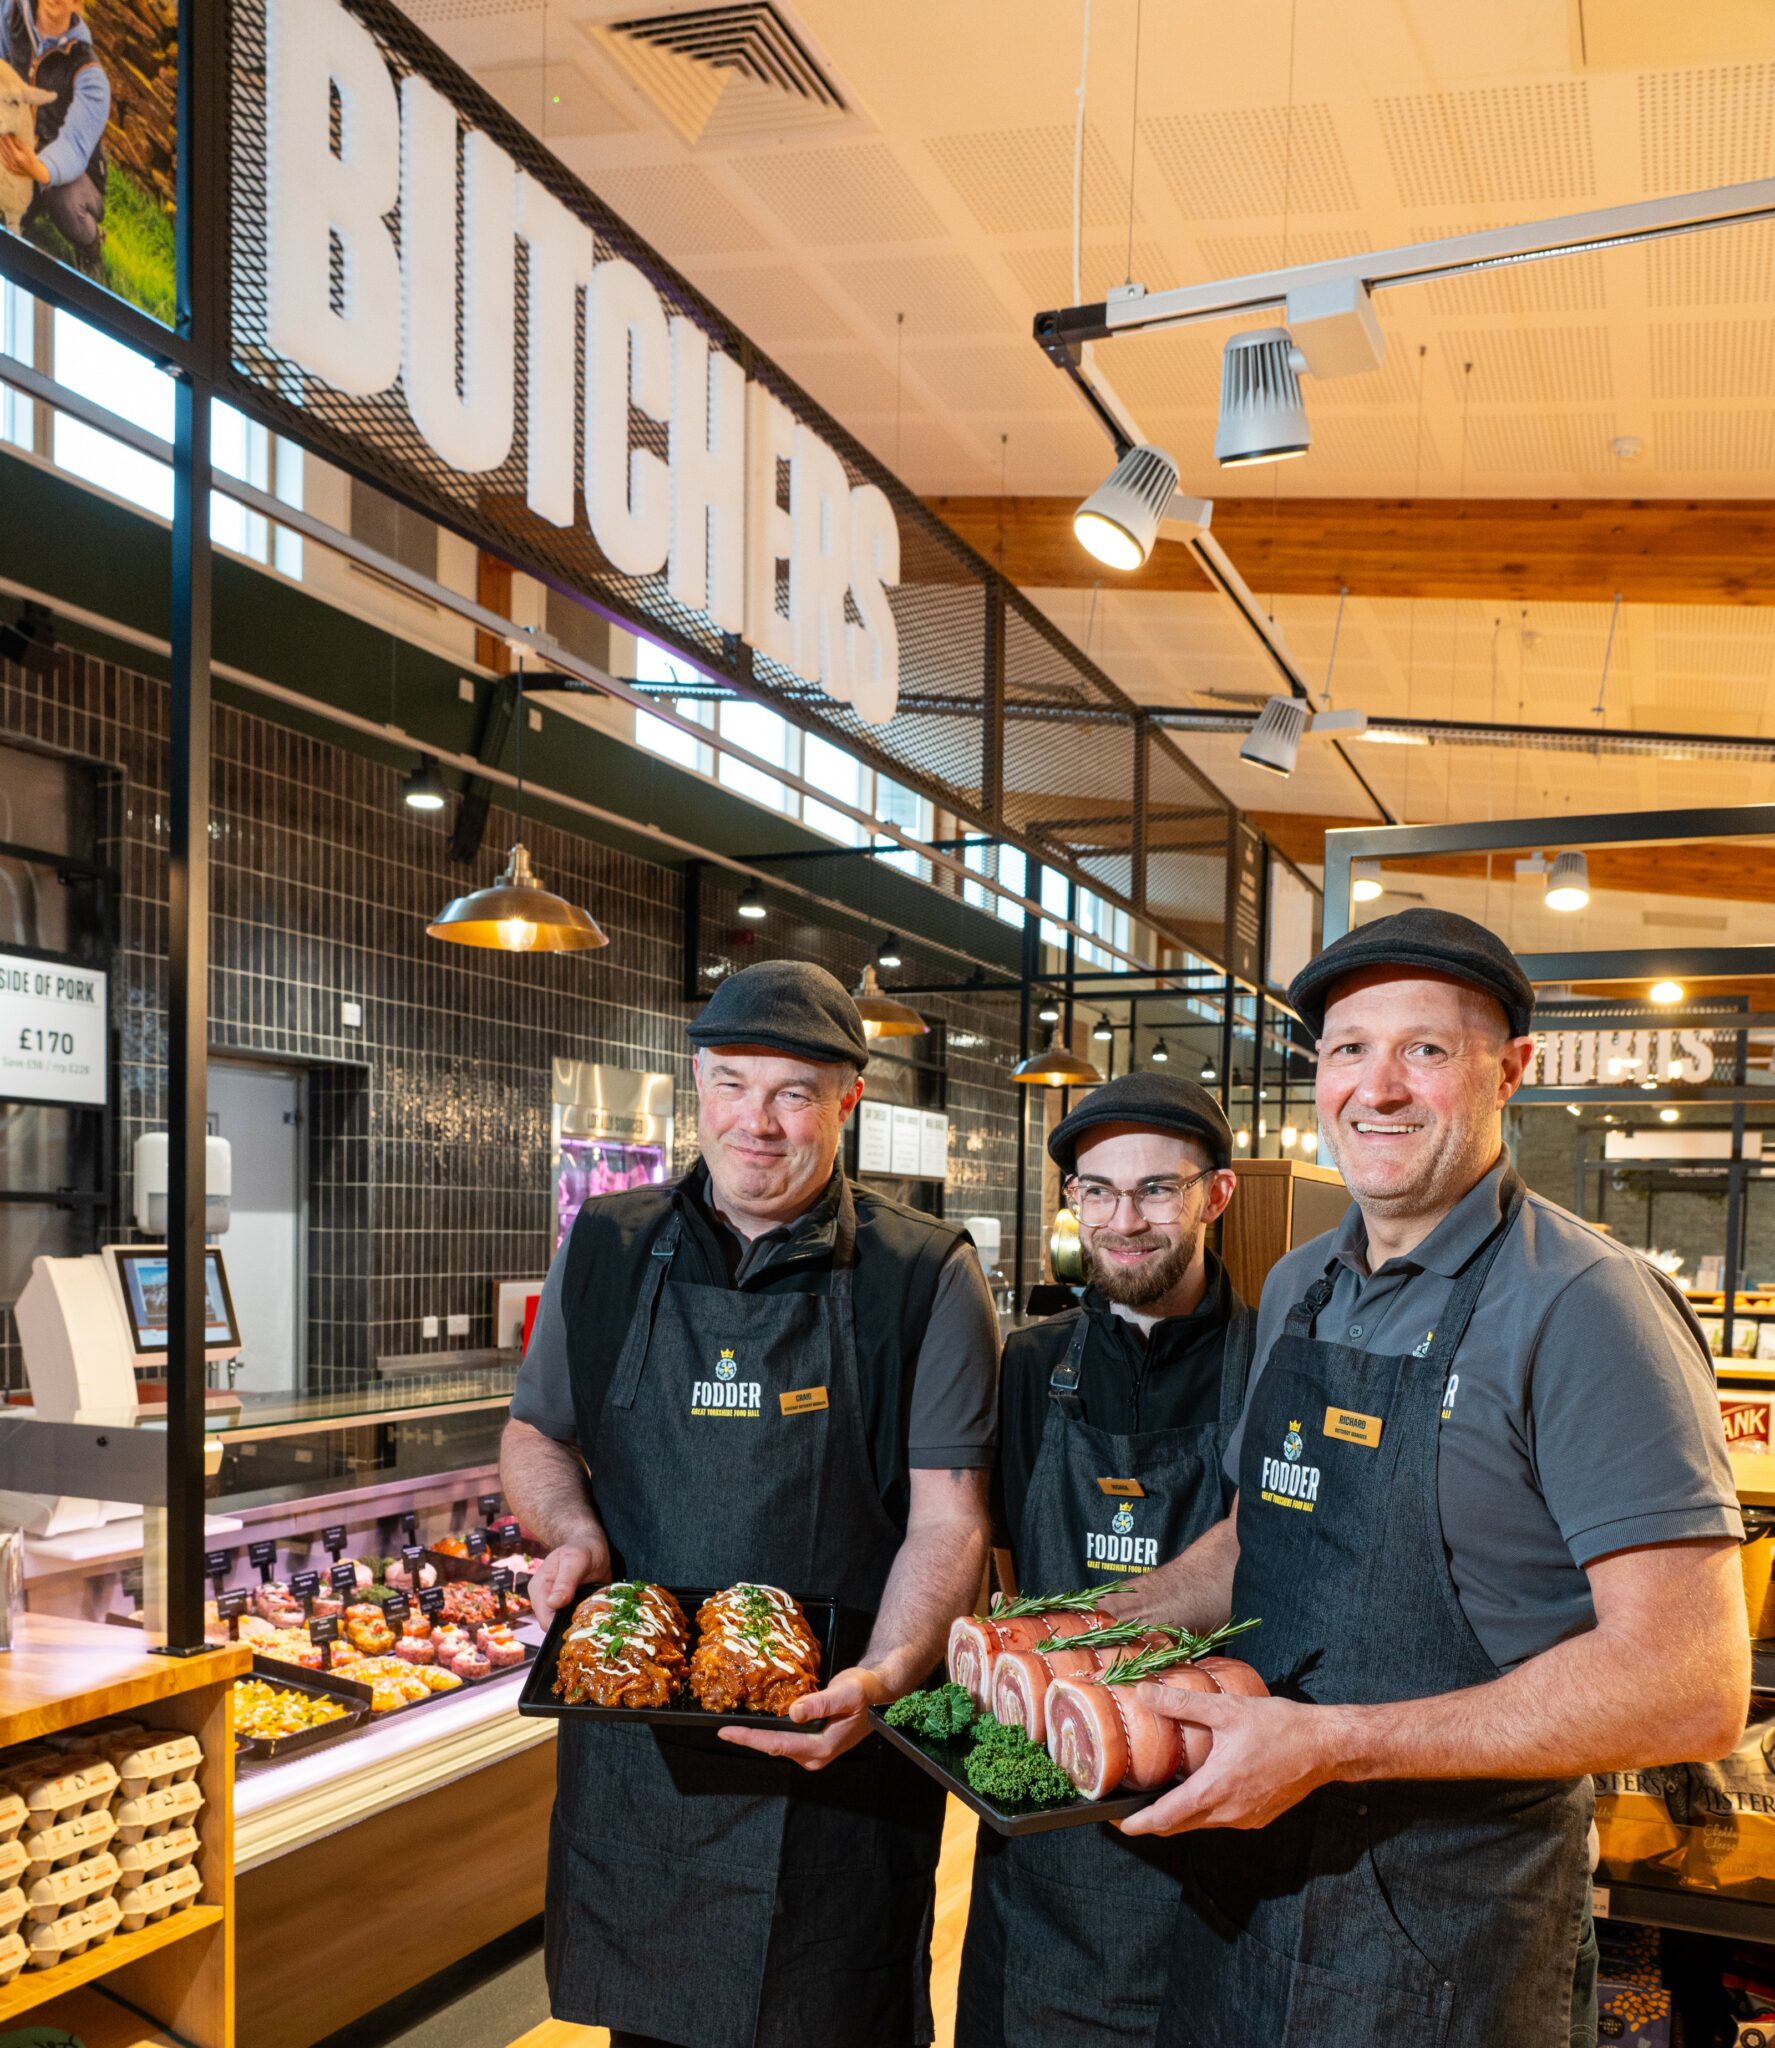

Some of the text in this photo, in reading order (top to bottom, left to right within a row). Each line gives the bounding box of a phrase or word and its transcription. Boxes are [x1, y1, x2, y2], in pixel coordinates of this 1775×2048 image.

[265, 0, 902, 725] BUTCHERS
[0, 967, 95, 1004] SIDE OF PORK
[19, 1027, 73, 1056] £170
[691, 1381, 761, 1408] FODDER
[1338, 1415, 1367, 1430] RICHARD
[1261, 1456, 1320, 1502] FODDER
[1086, 1532, 1158, 1566] FODDER
